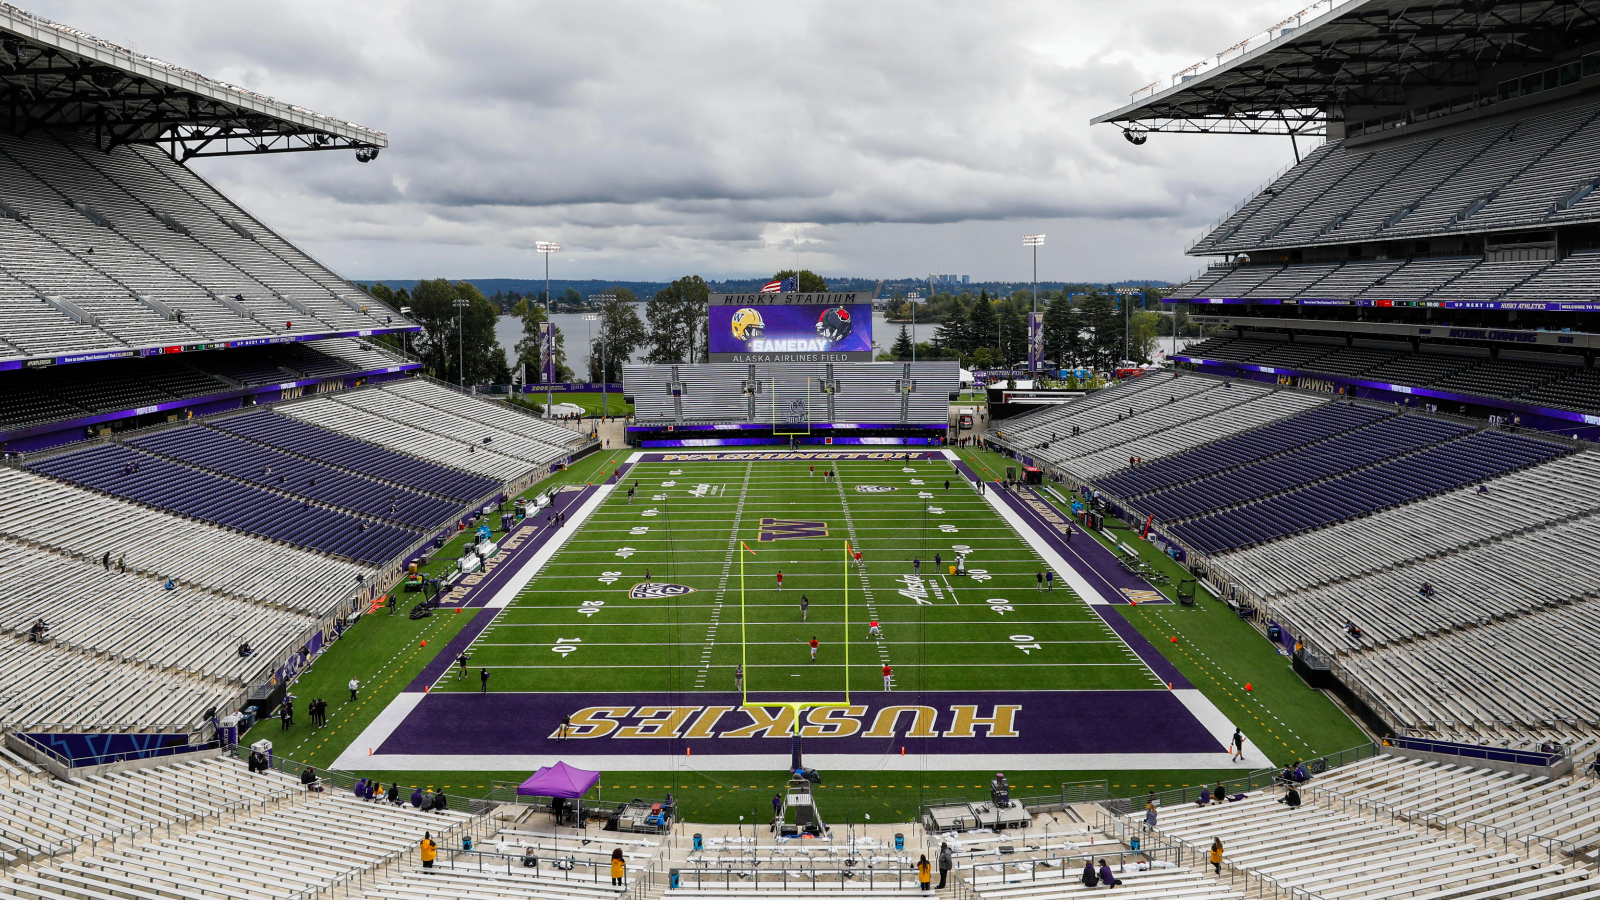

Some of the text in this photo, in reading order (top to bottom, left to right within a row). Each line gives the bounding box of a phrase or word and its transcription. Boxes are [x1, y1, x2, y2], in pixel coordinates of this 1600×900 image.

[724, 293, 857, 304] HUSKY STADIUM
[733, 312, 745, 322] W
[753, 339, 826, 352] GAMEDAY
[732, 354, 771, 363] ALASKA
[774, 354, 818, 362] AIRLINES
[662, 452, 923, 461] WASHINGTON
[757, 517, 830, 542] W
[373, 560, 403, 599] HUSKIES
[597, 571, 622, 582] 30
[967, 569, 992, 580] 30
[440, 586, 473, 604] THE
[1120, 588, 1165, 603] W
[577, 600, 605, 614] 20
[986, 598, 1015, 612] 20
[551, 637, 582, 653] 10
[1009, 634, 1042, 650] 10
[547, 705, 1023, 739] HUSKIES
